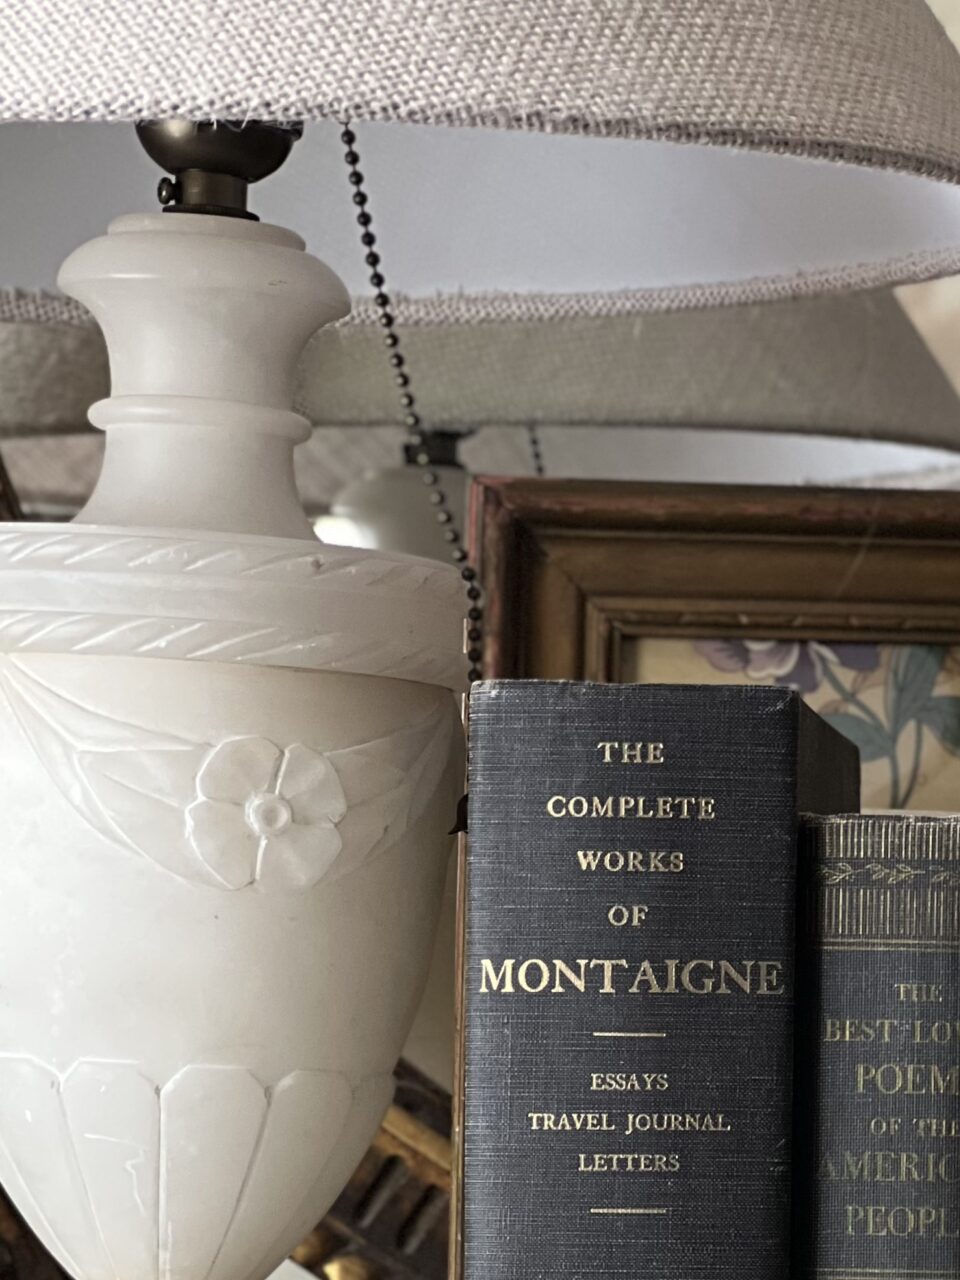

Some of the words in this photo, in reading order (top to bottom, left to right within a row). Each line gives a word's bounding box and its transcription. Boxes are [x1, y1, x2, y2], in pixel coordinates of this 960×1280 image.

[598, 741, 664, 764] THE
[546, 795, 716, 820] COMPLETE
[577, 851, 685, 872] WORKS
[607, 904, 649, 926] OF
[480, 958, 785, 995] MONTAIGNE
[894, 983, 944, 1003] THE
[590, 1073, 669, 1091] ESSAYS
[528, 1112, 615, 1131] TRAVEL
[625, 1112, 731, 1134] JOURNAL
[870, 1118, 902, 1136] OF
[578, 1153, 680, 1172] LETTERS
